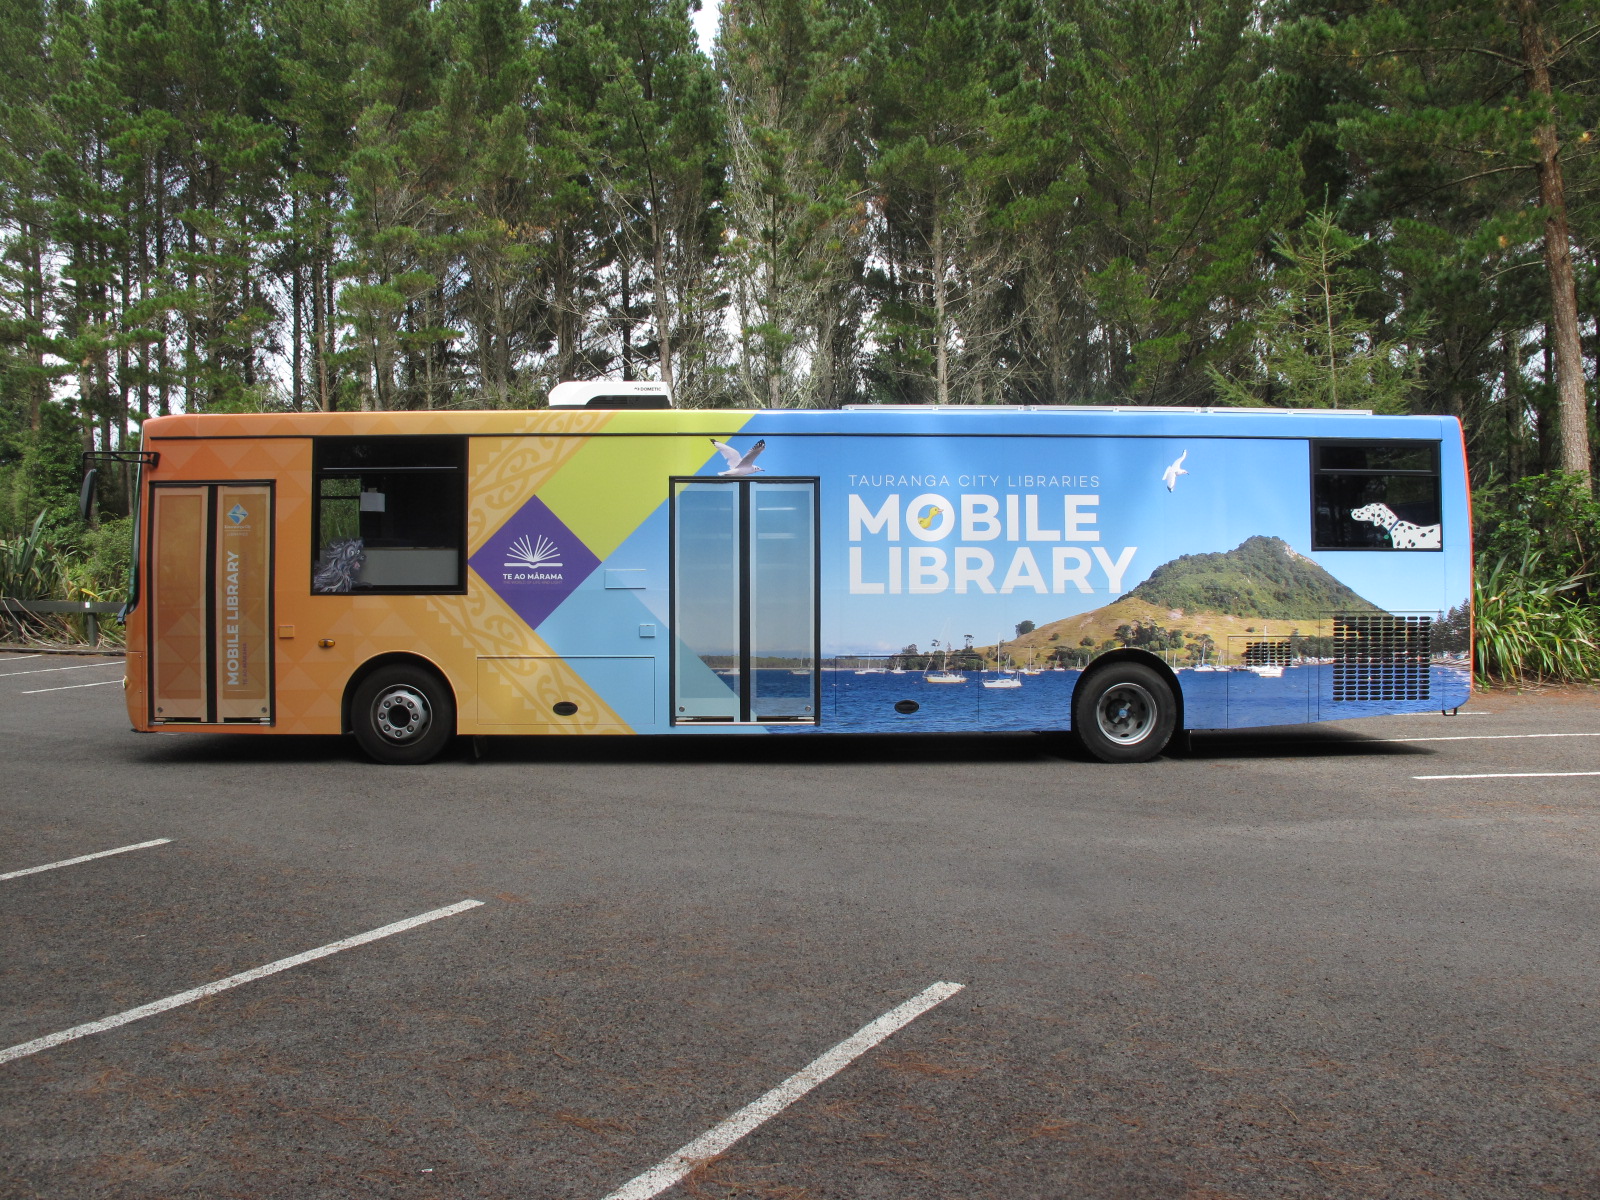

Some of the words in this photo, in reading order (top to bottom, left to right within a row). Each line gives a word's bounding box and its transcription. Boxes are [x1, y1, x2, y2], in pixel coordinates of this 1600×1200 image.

[848, 474, 950, 487] TAURANGA
[958, 475, 1000, 487] CITY
[1008, 475, 1100, 488] LIBRARIES
[848, 493, 1100, 542] MOBILE
[226, 551, 239, 620] LIBRARY
[849, 547, 1138, 594] LIBRARY
[226, 625, 239, 685] MOBILE
